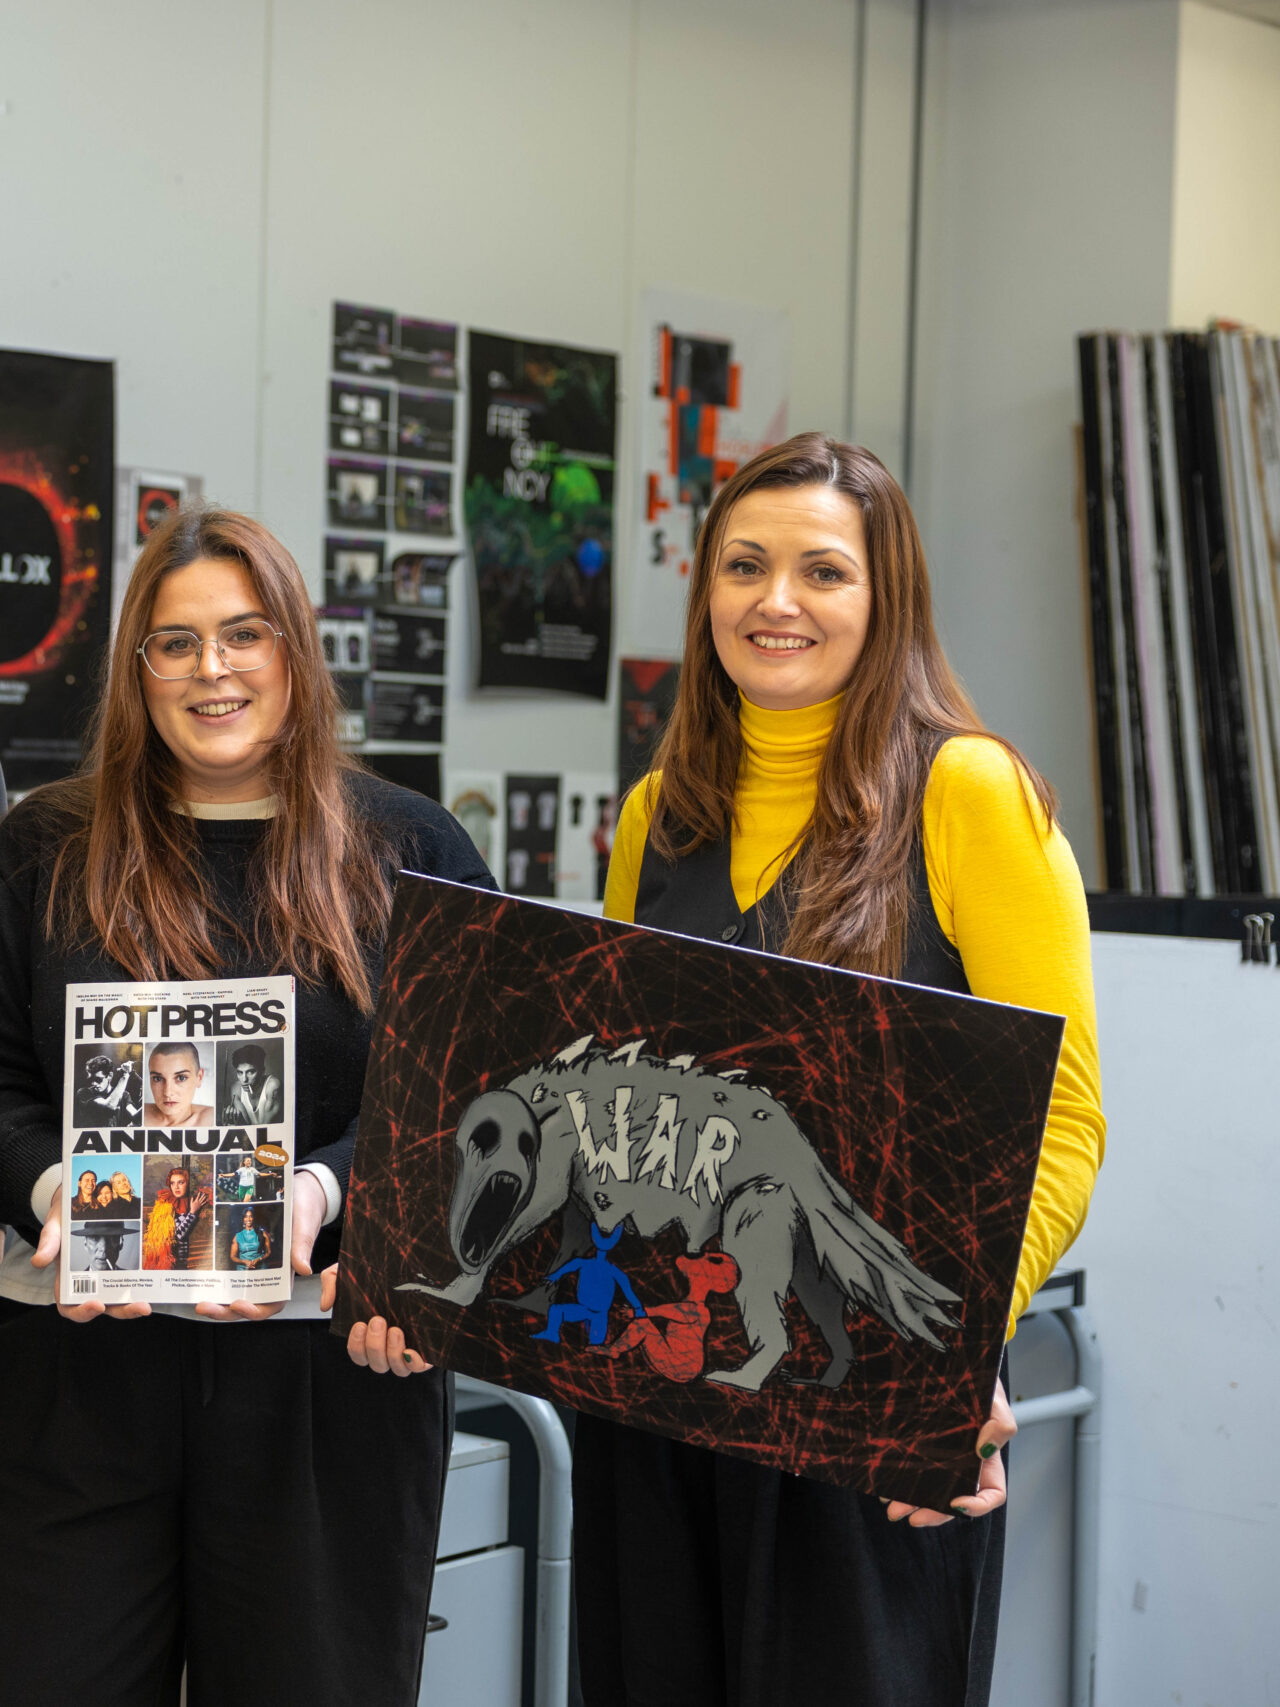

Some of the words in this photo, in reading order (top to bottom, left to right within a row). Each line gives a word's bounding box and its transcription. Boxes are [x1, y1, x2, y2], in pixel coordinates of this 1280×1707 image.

[75, 1004, 158, 1039] HOT
[161, 998, 286, 1038] PRESS
[72, 1127, 282, 1154] ANNUAL
[258, 1150, 286, 1162] 2024
[564, 1085, 742, 1210] WAR
